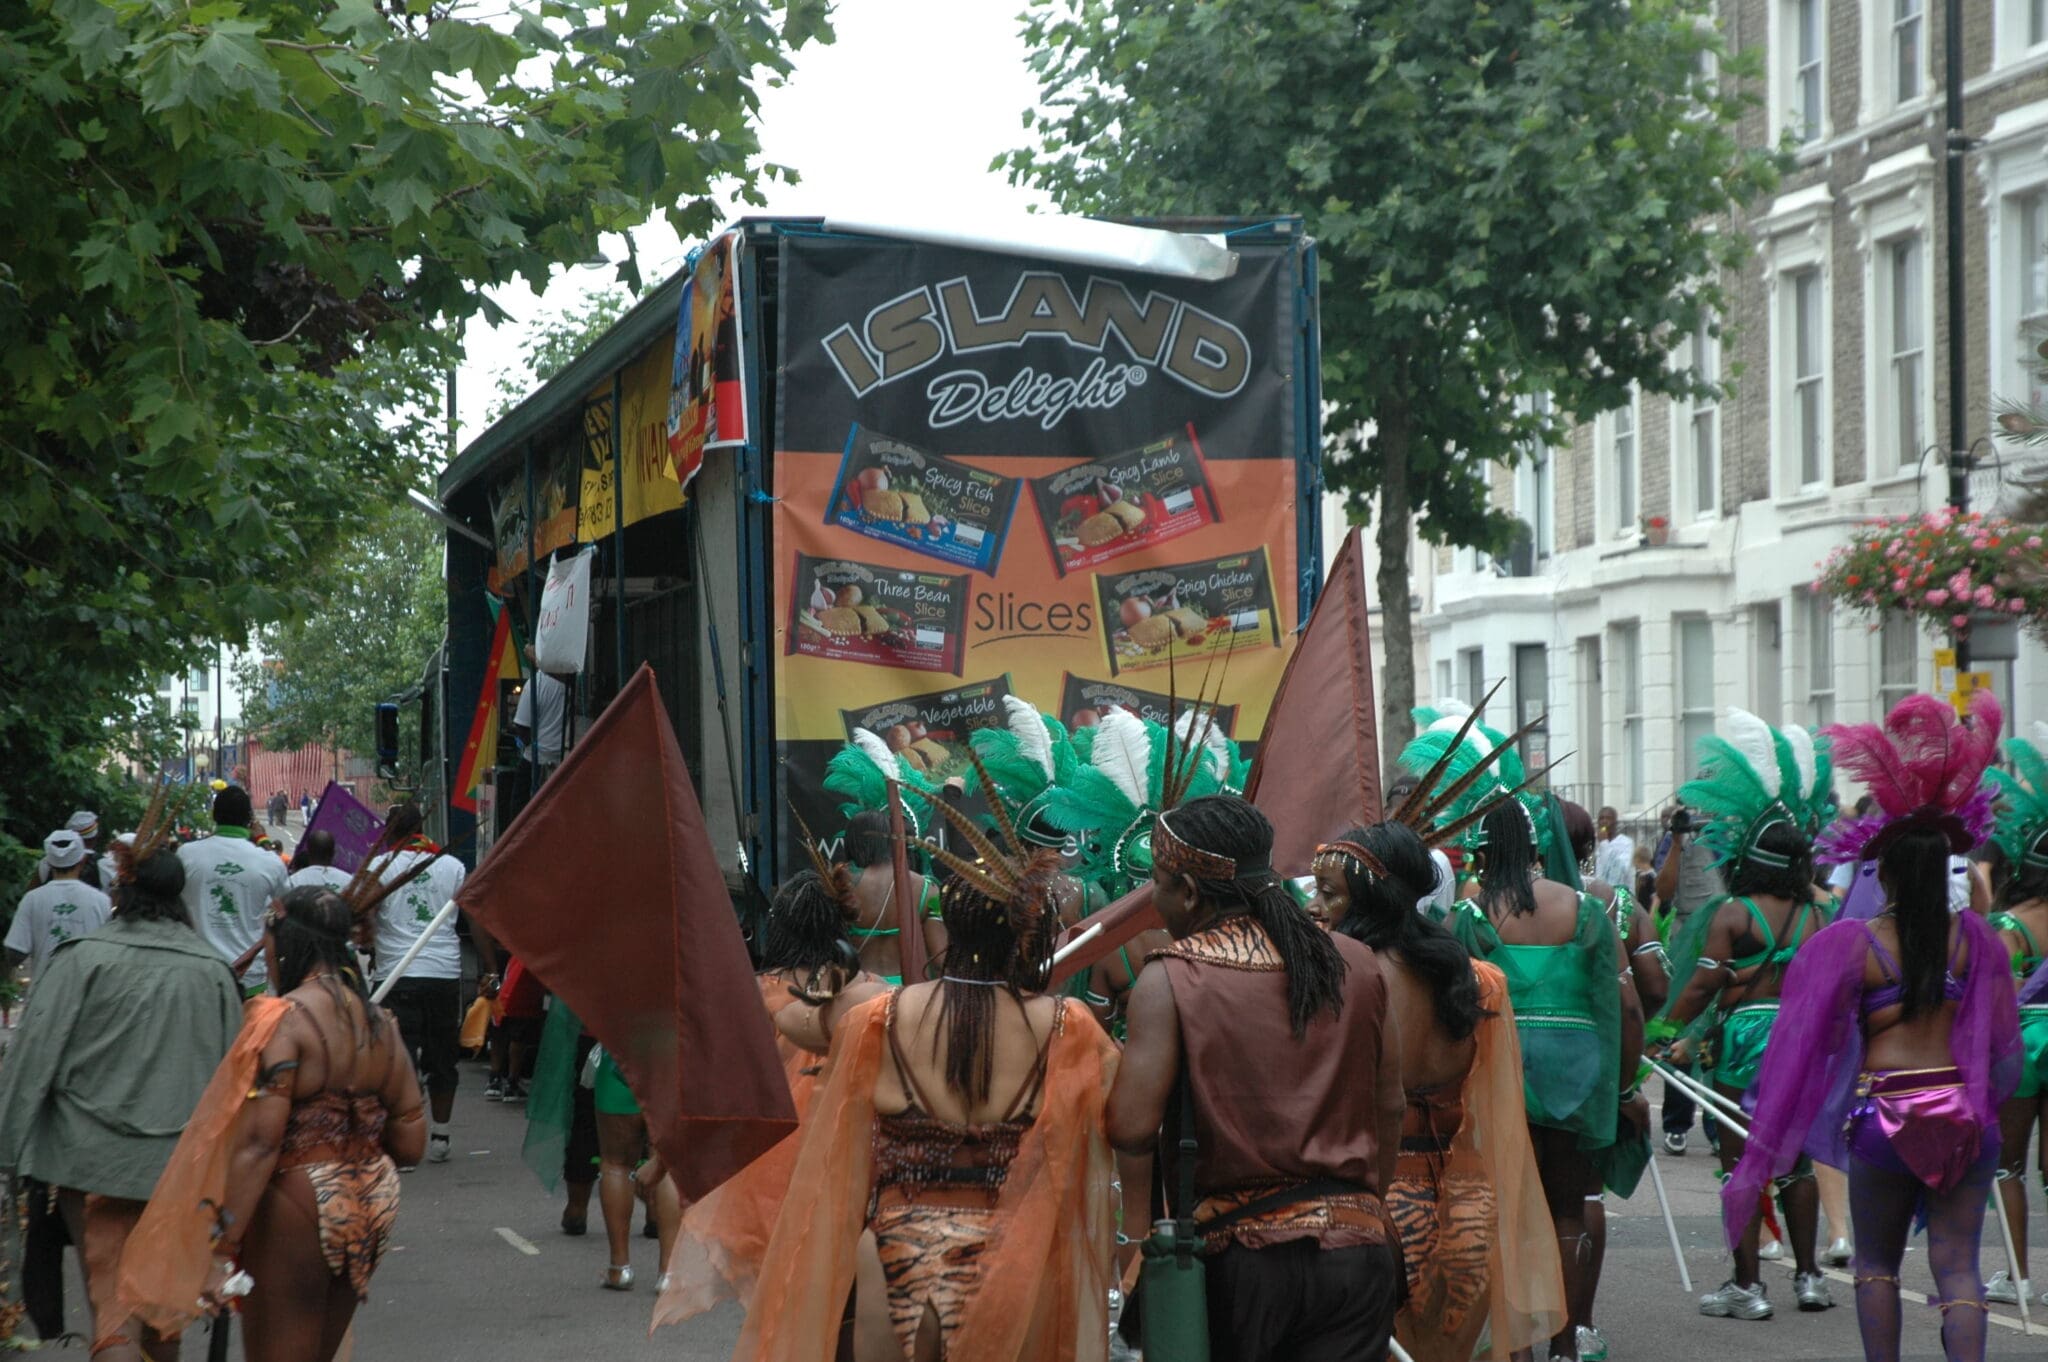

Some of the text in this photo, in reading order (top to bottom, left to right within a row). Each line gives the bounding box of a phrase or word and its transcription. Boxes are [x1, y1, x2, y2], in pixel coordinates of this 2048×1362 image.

[821, 270, 1252, 398] ISLAND
[1109, 466, 1141, 487] Spicy
[1141, 449, 1180, 475] Lamb
[1152, 467, 1184, 486] Slice
[925, 466, 962, 496] Spicy
[966, 481, 994, 502] Fish
[959, 496, 990, 516] Slice
[874, 578, 910, 599] Three
[914, 585, 951, 603] Bean
[1176, 578, 1207, 598] Spicy
[1208, 571, 1254, 590] Chicken
[1221, 586, 1254, 602] Slice
[914, 602, 946, 618] Slice
[975, 592, 1092, 631] Slices
[920, 696, 996, 727] Vegetable
[965, 715, 999, 730] Slice
[1141, 704, 1176, 724] Spic
